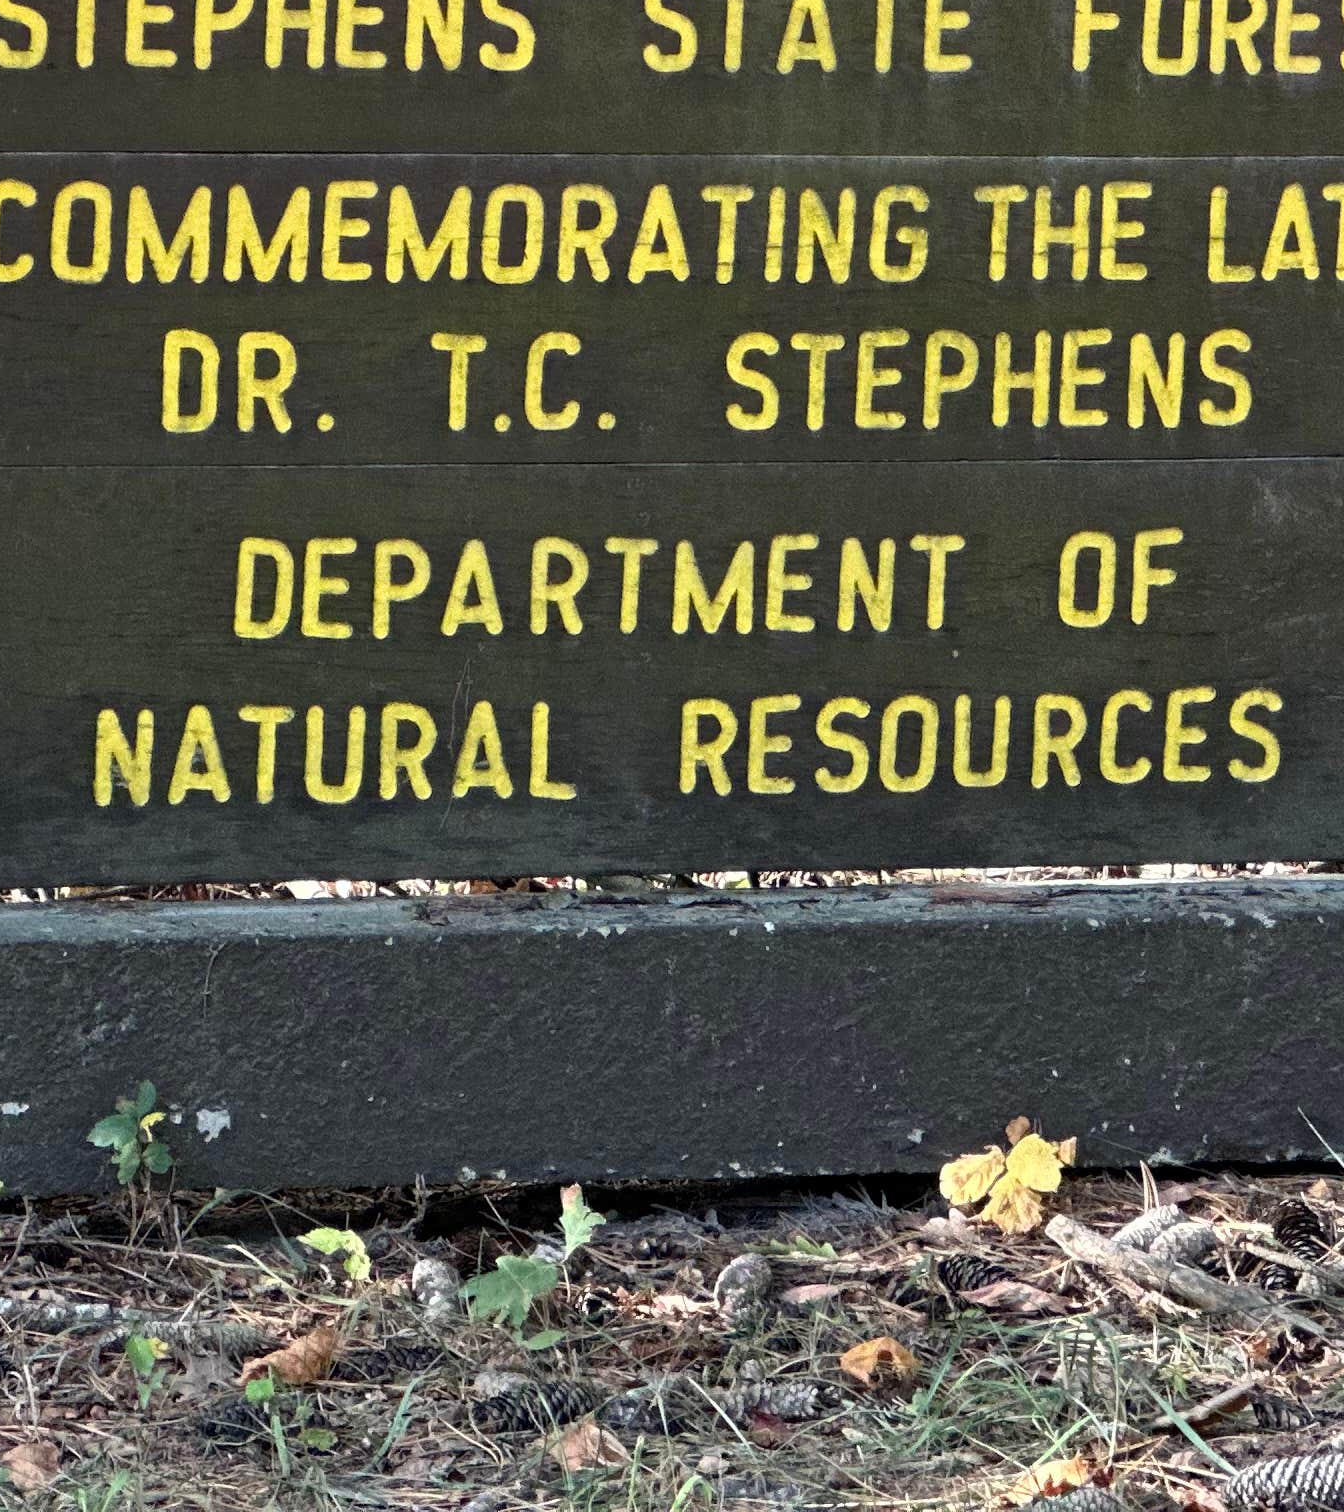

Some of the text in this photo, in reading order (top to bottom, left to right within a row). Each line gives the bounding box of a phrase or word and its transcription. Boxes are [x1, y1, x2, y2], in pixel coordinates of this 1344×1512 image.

[974, 182, 1152, 281] THE
[162, 328, 1252, 433] DR. T.C. STEPHENS
[234, 528, 1183, 639] DEPARTMENT OF
[94, 687, 1282, 806] NATURAL RESOURCES
